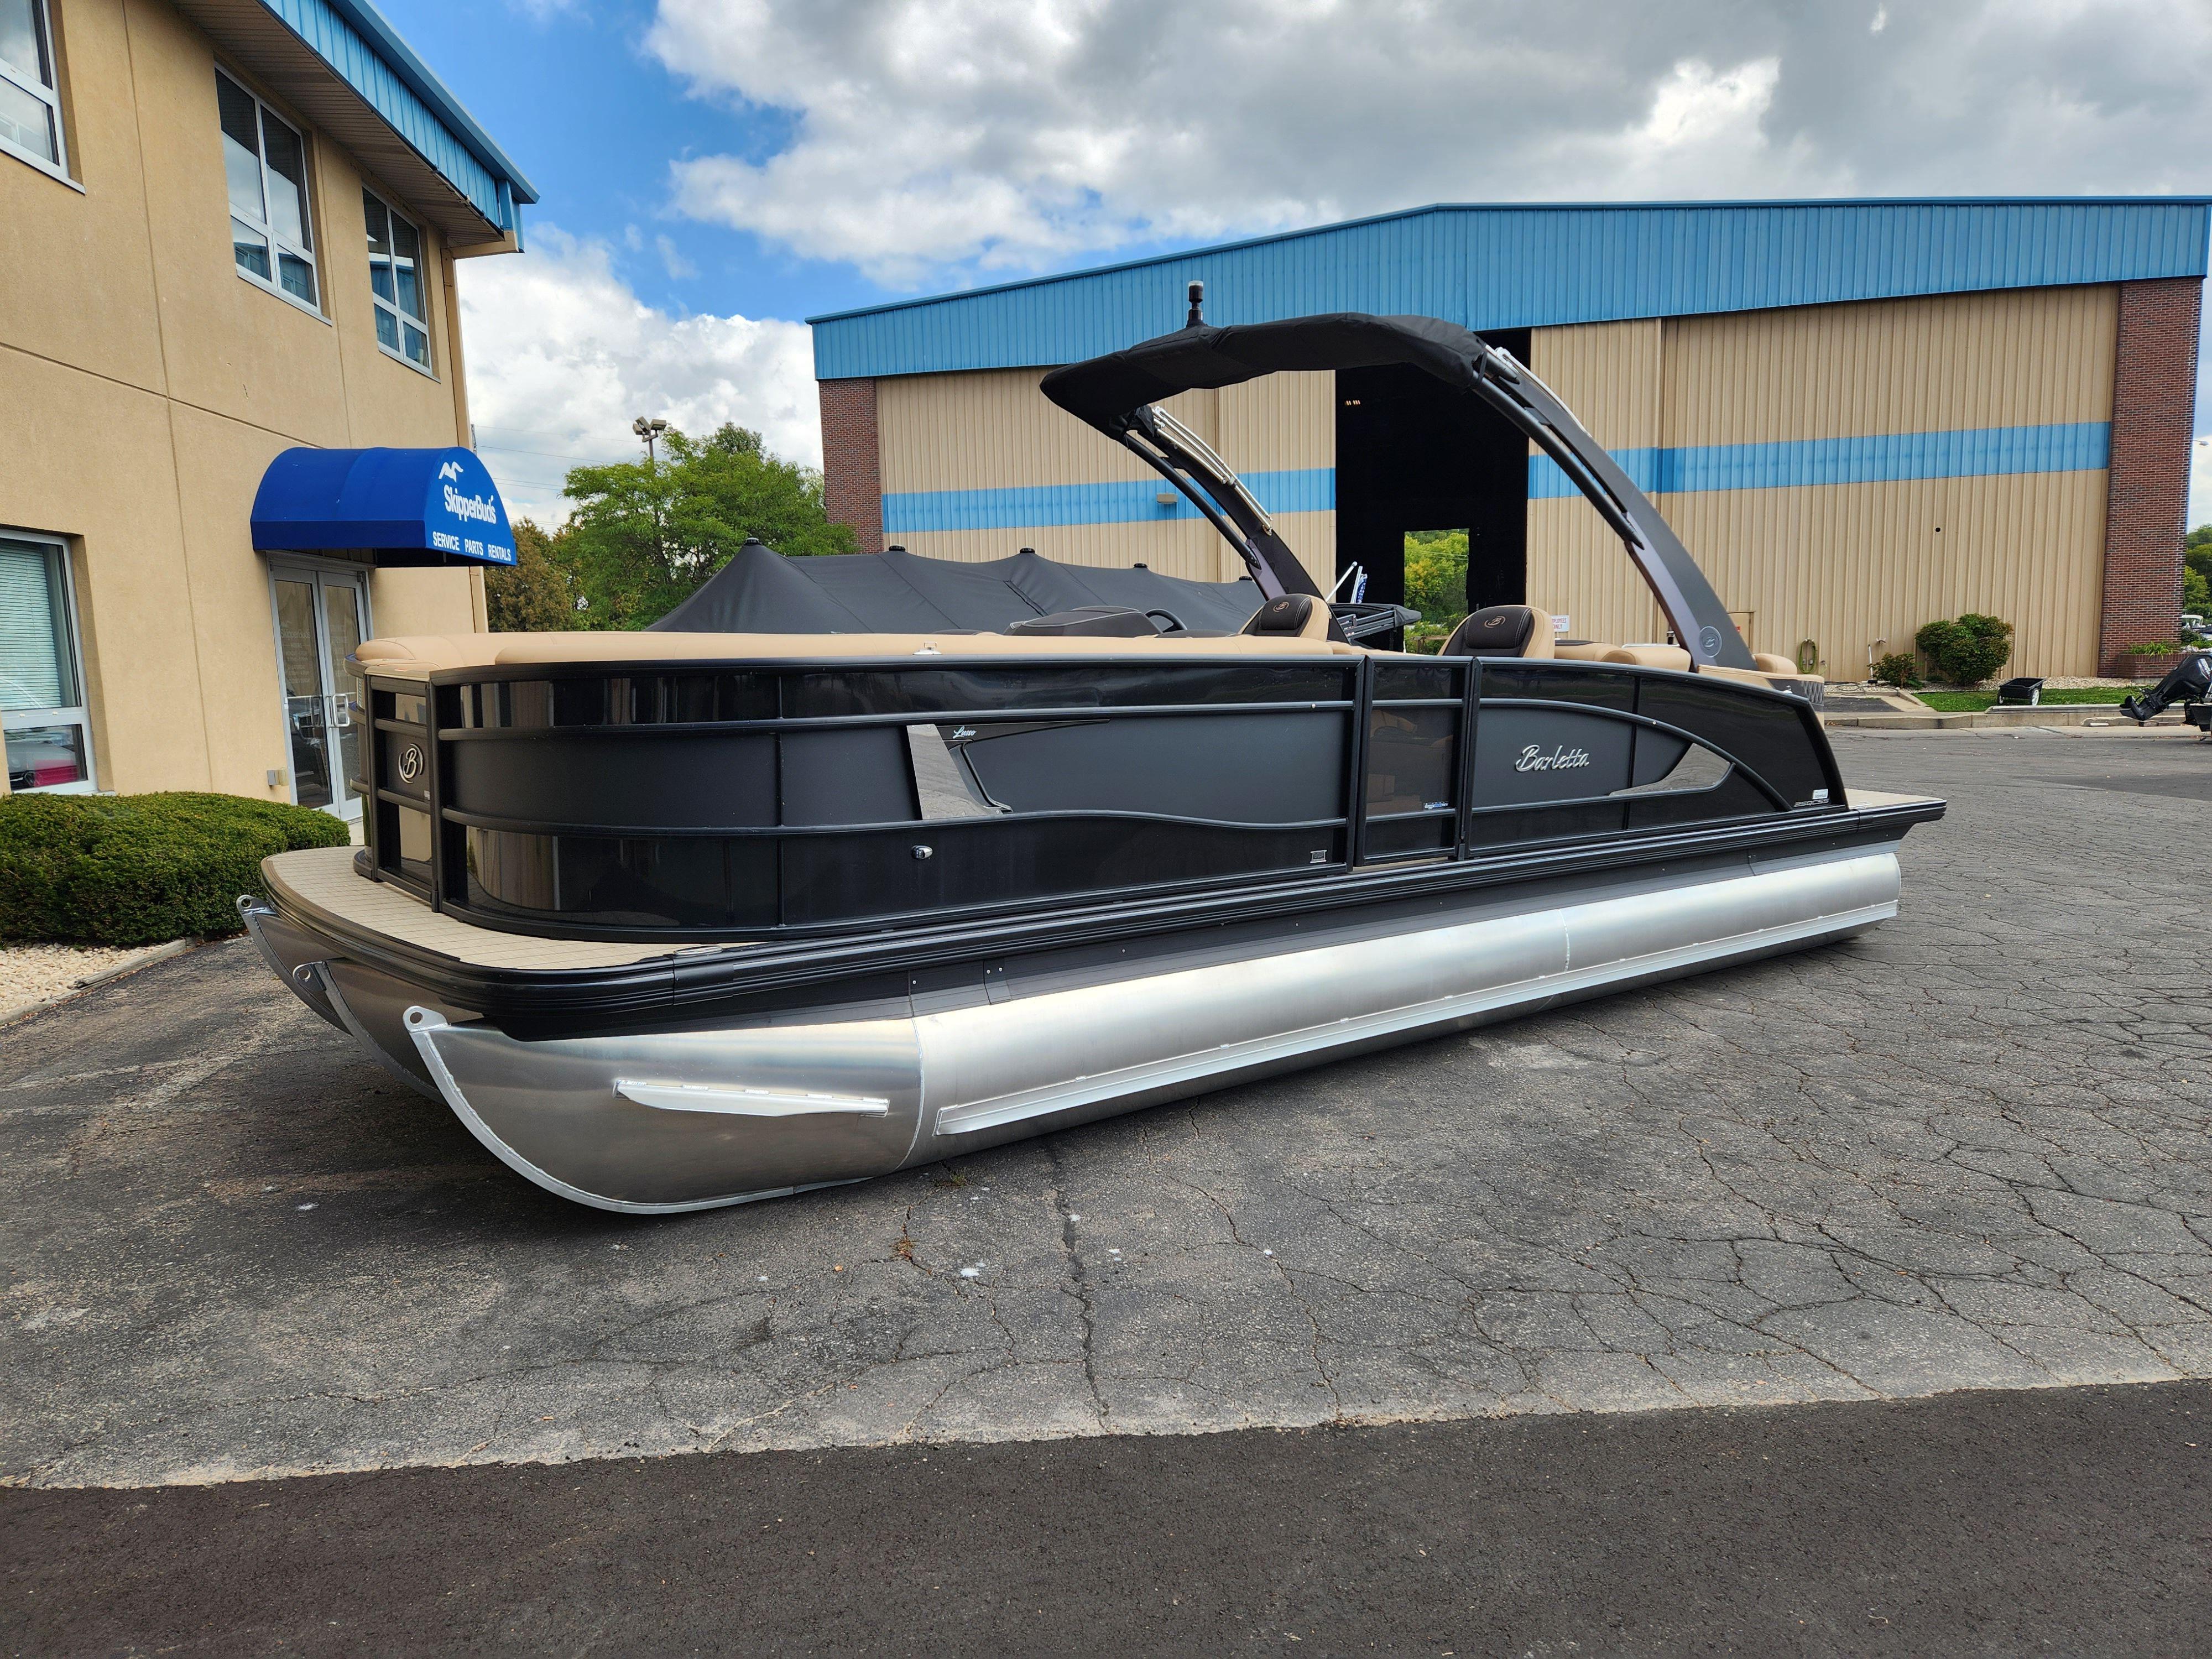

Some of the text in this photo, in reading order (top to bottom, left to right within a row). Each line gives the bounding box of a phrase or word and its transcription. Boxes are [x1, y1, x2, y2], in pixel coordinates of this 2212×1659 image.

[444, 484, 497, 524] SkipperBud's
[432, 531, 512, 561] SERVICE PARTS RENTALS
[952, 726, 977, 739] Lusso
[1516, 744, 1590, 772] Barletta
